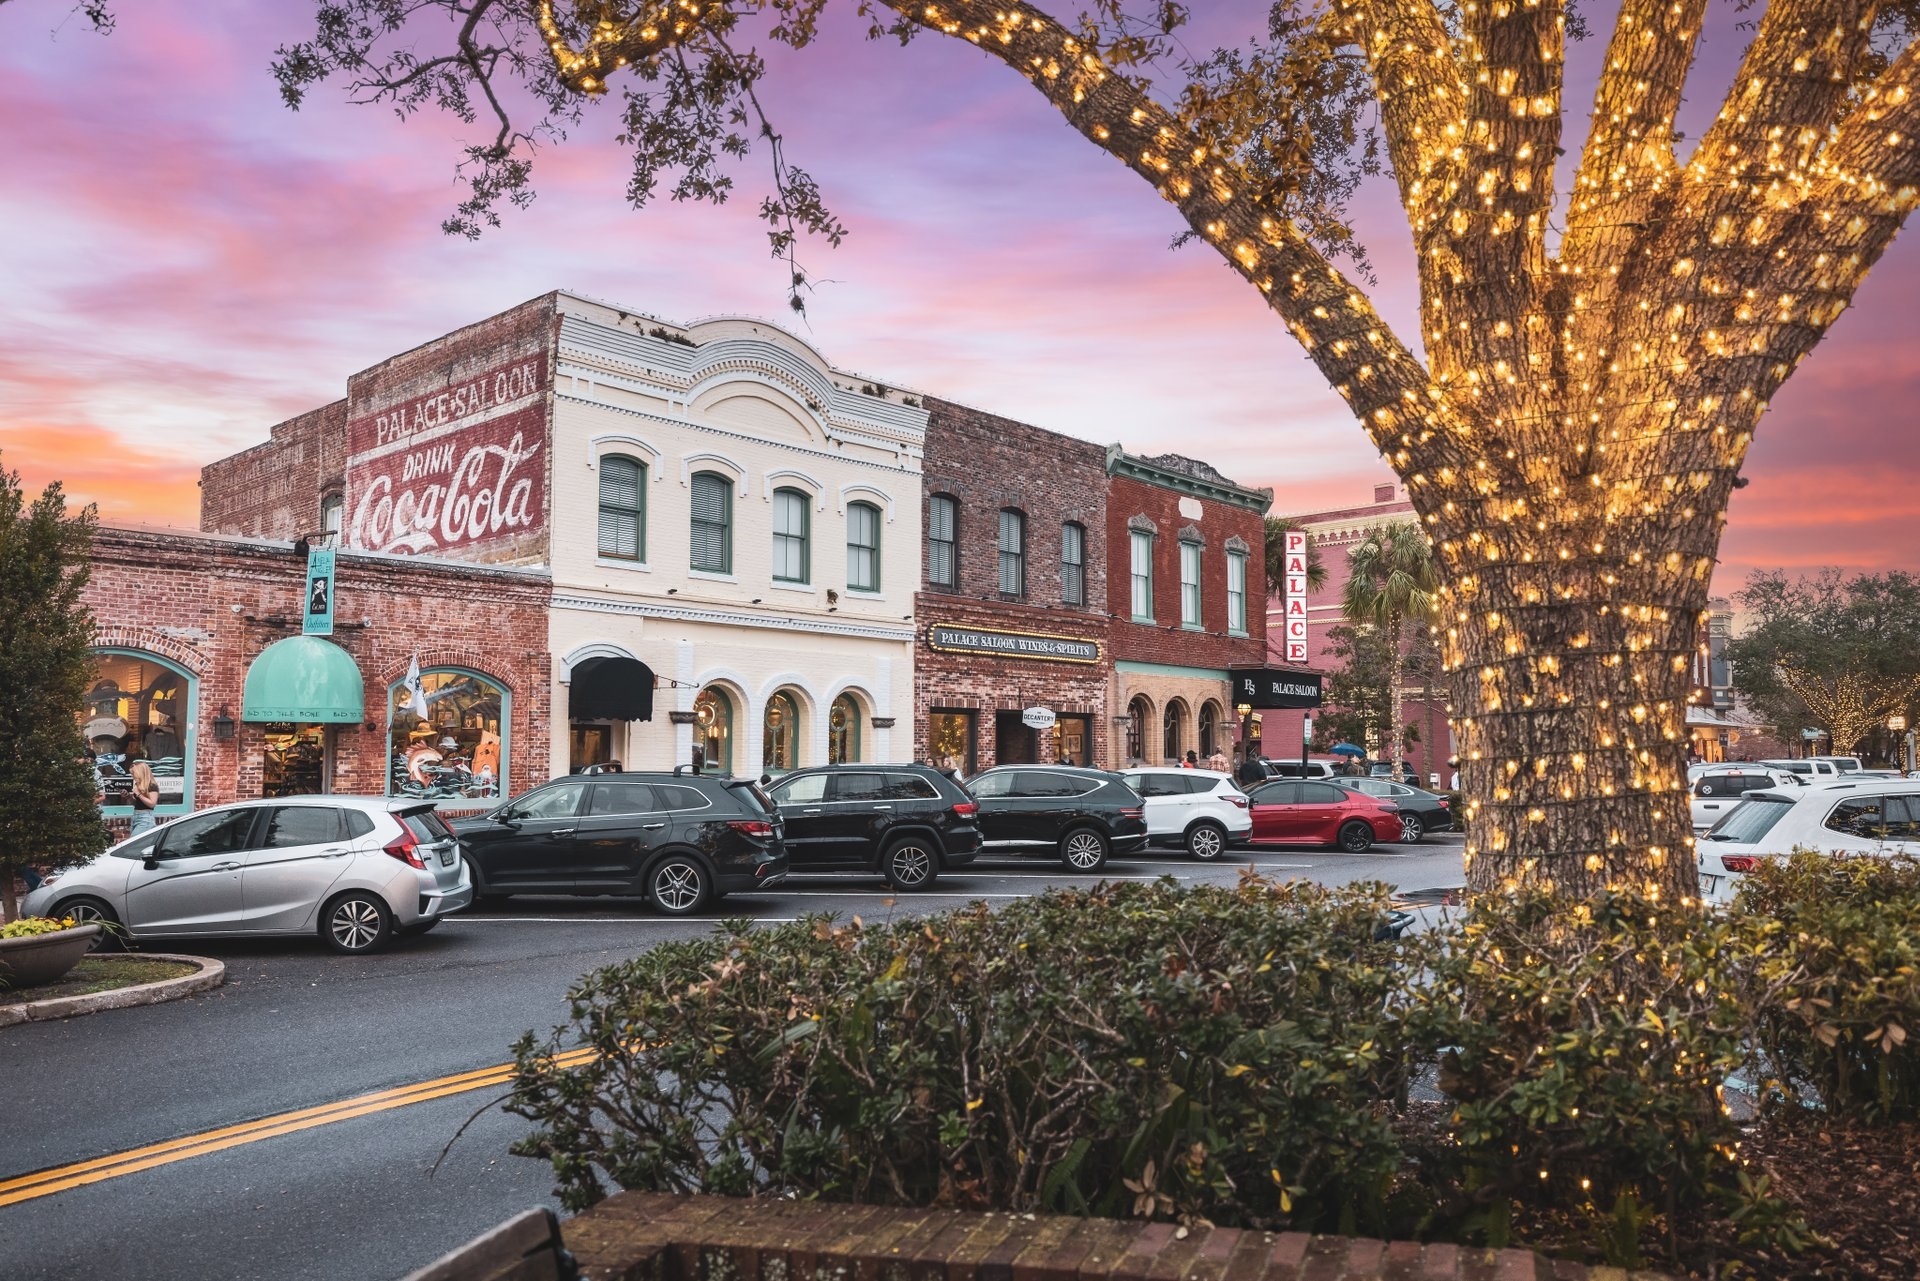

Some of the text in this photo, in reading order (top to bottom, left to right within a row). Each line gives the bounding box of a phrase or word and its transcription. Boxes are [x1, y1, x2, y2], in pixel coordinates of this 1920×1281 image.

[376, 361, 538, 446] PALACE SALOON
[402, 442, 456, 483] DRINK
[350, 430, 542, 552] Coca-Cola
[1288, 535, 1305, 658] PALACE
[941, 632, 978, 646] PALACE
[981, 636, 1015, 649] SALOON
[1272, 682, 1318, 696] PALACE SALOON
[1023, 714, 1054, 722] DECANTERY
